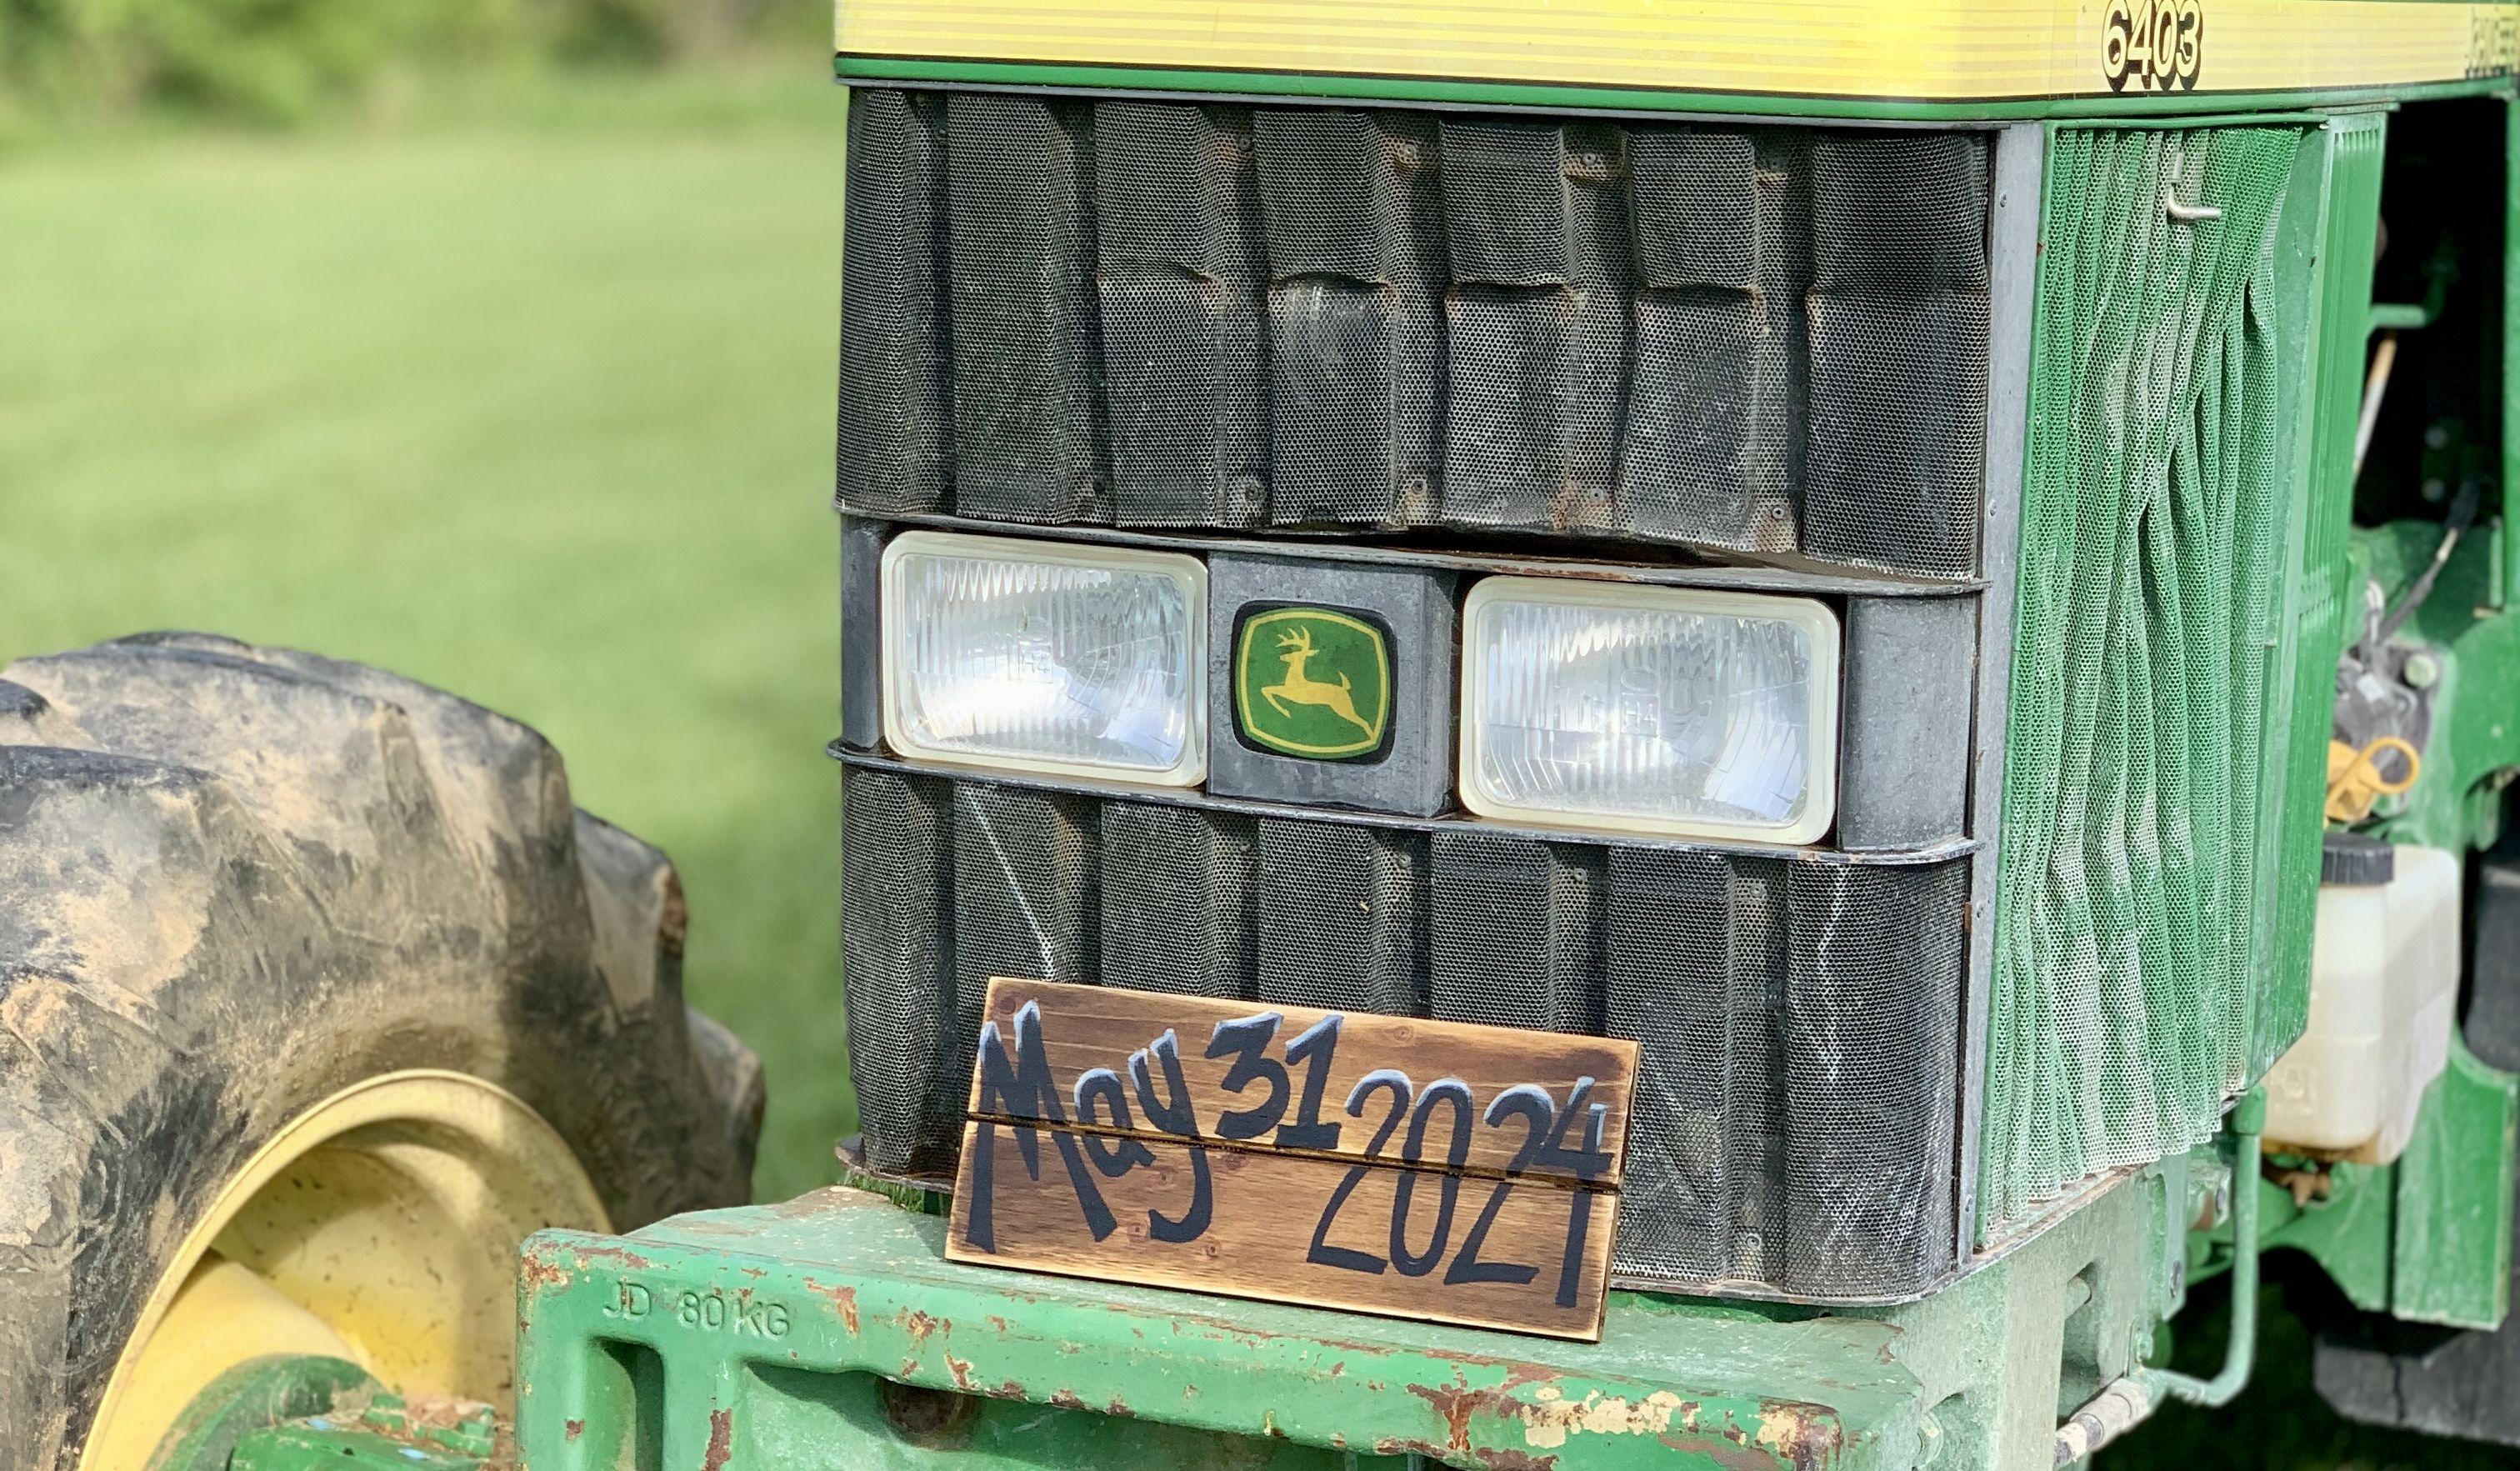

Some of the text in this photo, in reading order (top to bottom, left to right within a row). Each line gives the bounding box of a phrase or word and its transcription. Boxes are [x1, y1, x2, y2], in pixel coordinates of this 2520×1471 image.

[2102, 0, 2203, 92] 6403
[965, 1000, 1613, 1308] May 31 2024
[603, 1281, 652, 1321] JD
